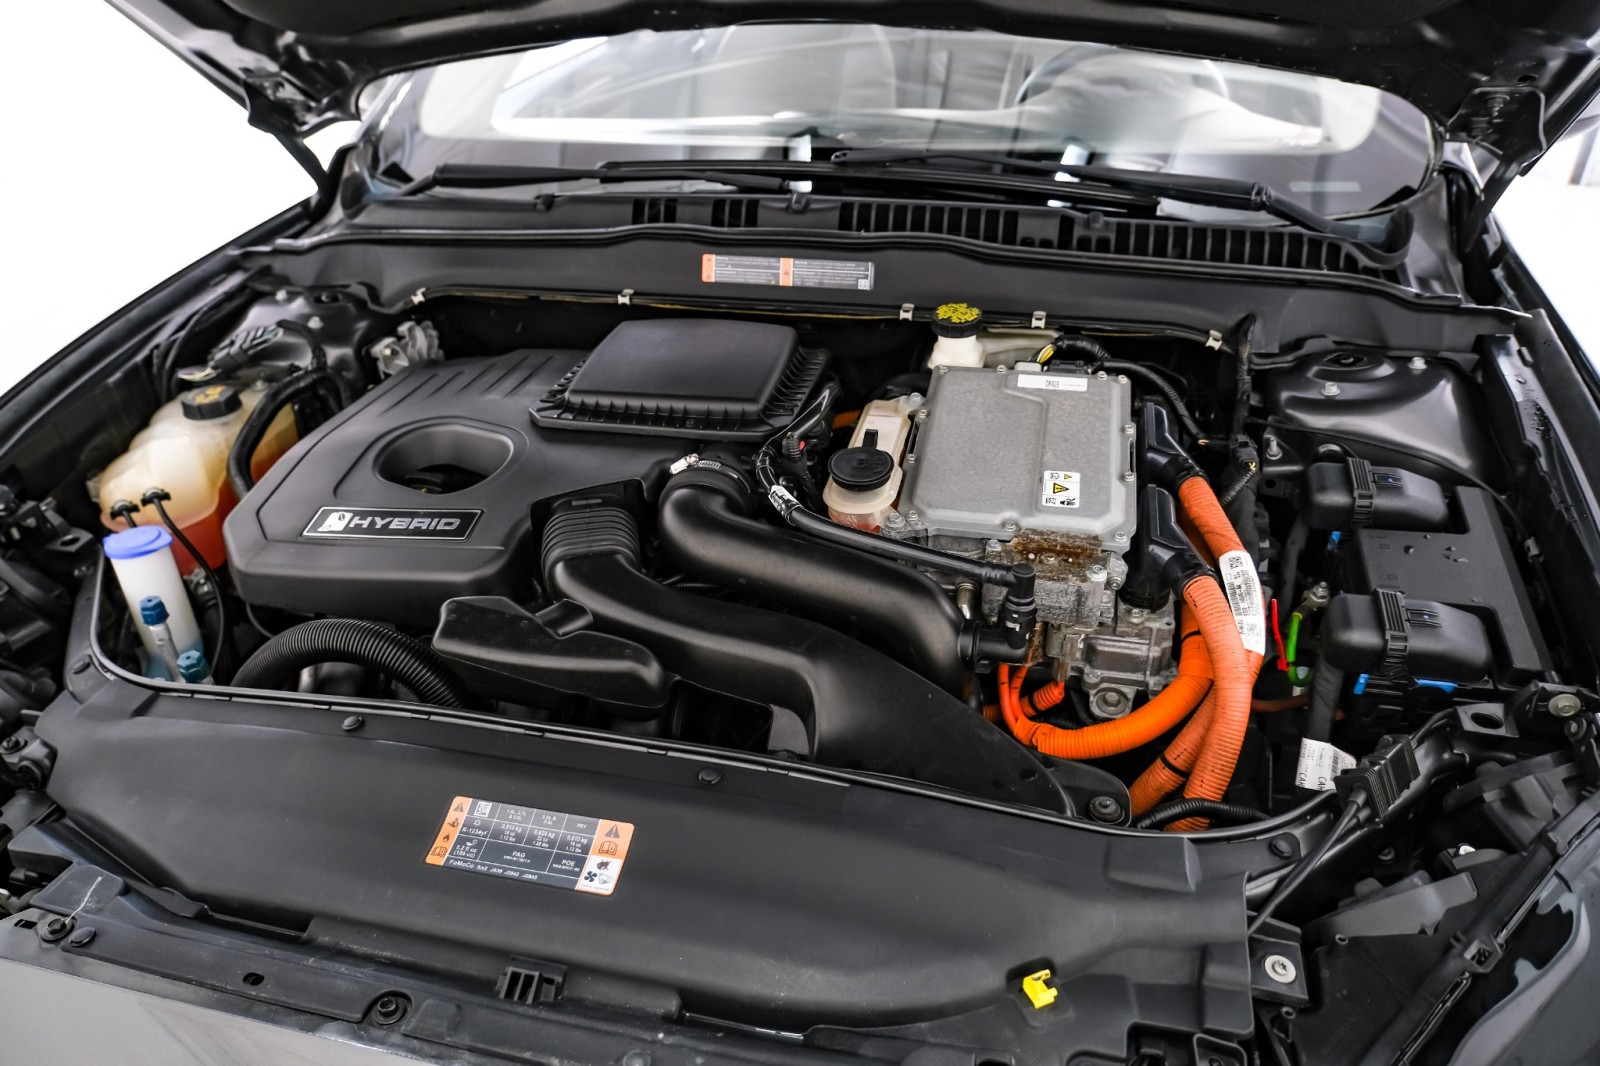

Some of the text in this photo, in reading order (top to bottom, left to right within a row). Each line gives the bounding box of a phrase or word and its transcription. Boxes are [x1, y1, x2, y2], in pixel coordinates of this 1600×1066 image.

[349, 516, 461, 530] HYBRID
[461, 826, 488, 837] R-1234yf
[449, 860, 475, 869] FoMoCo
